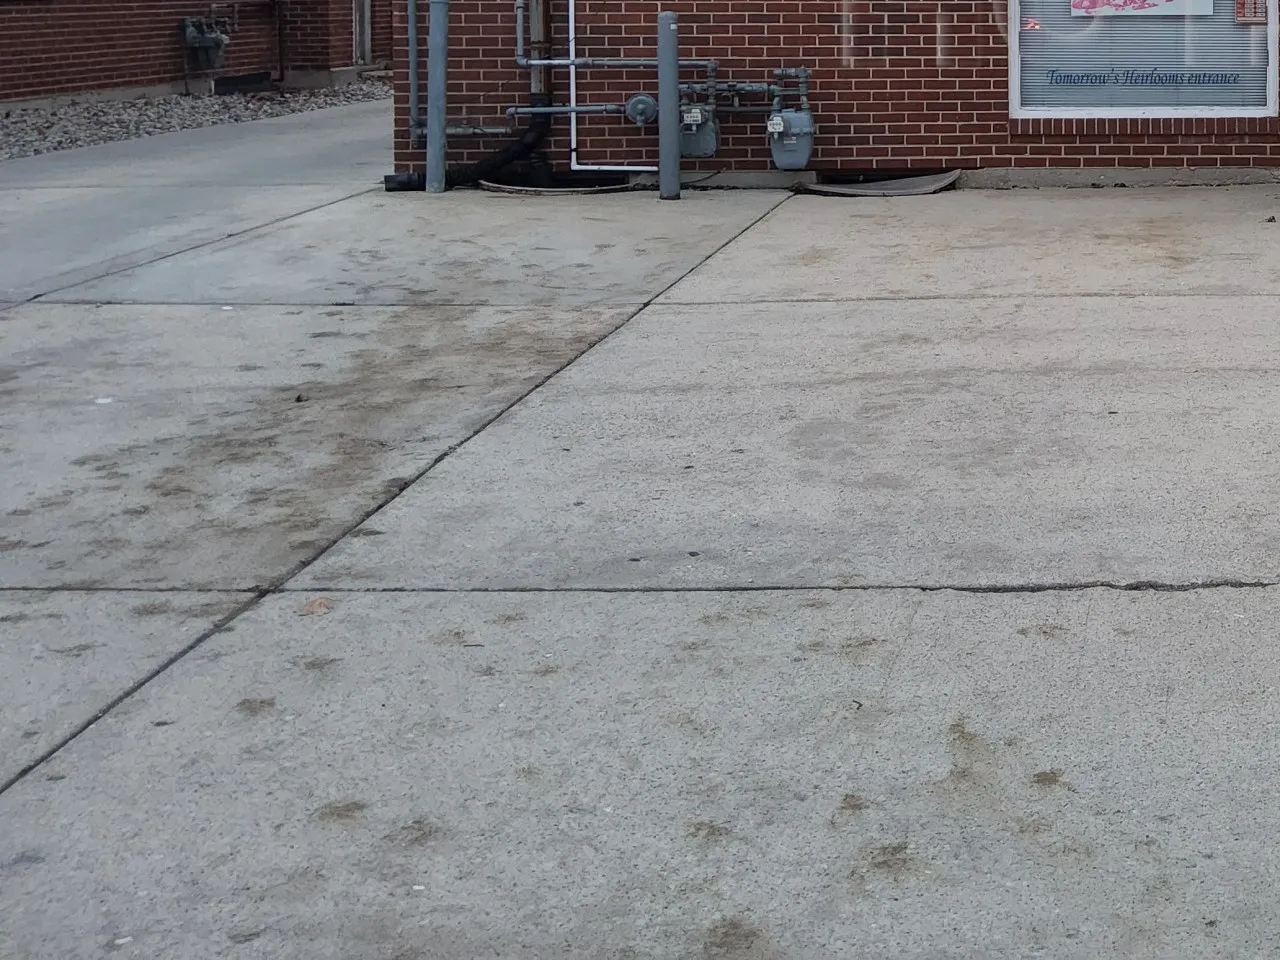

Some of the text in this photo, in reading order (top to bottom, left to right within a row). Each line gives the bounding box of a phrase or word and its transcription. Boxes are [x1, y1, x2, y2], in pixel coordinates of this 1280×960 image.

[1046, 67, 1241, 85] Tomorrow's Heirlooms entrance
